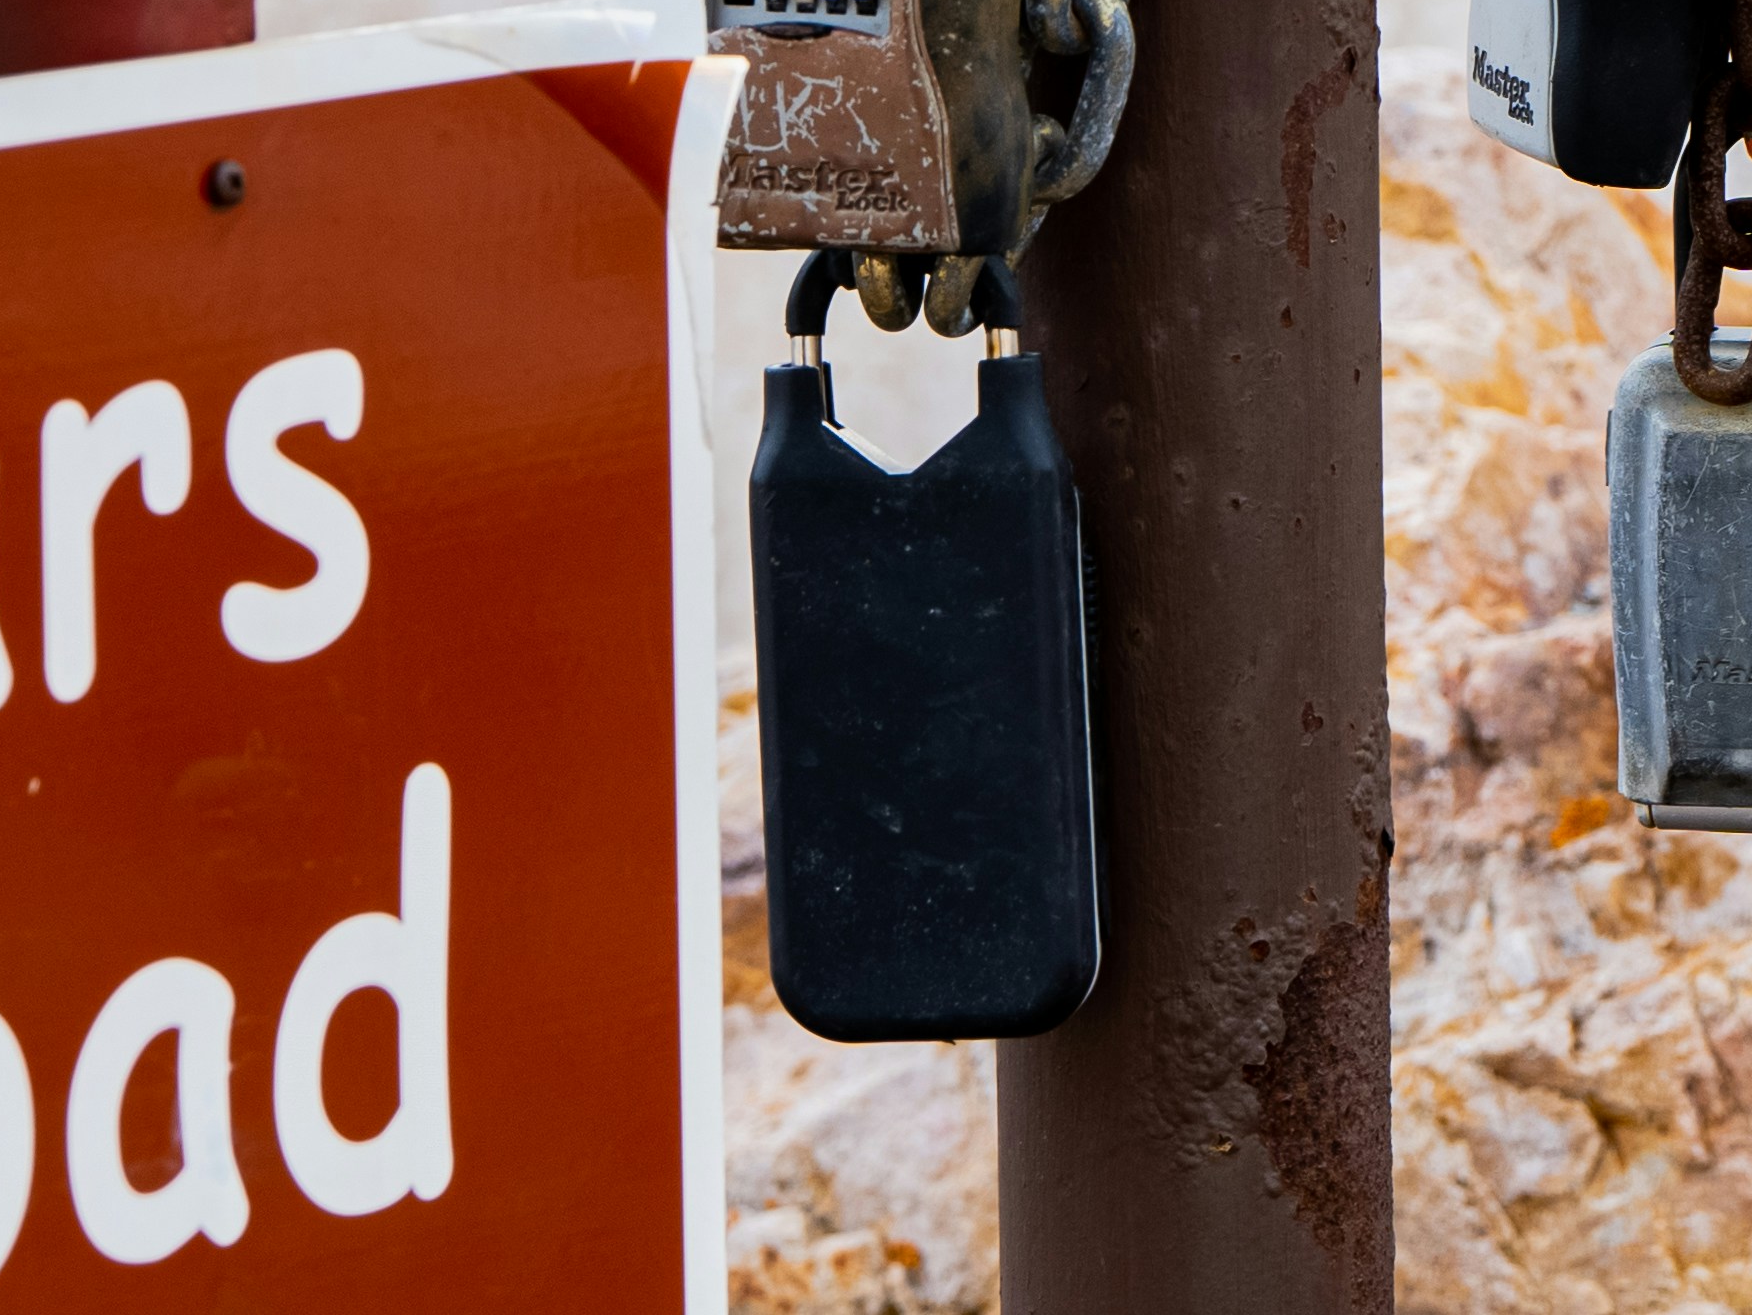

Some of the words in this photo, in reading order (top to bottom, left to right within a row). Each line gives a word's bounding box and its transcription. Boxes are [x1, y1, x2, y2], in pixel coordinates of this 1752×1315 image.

[1472, 45, 1531, 104] Master
[1507, 97, 1535, 127] Lock
[834, 190, 911, 213] Lock
